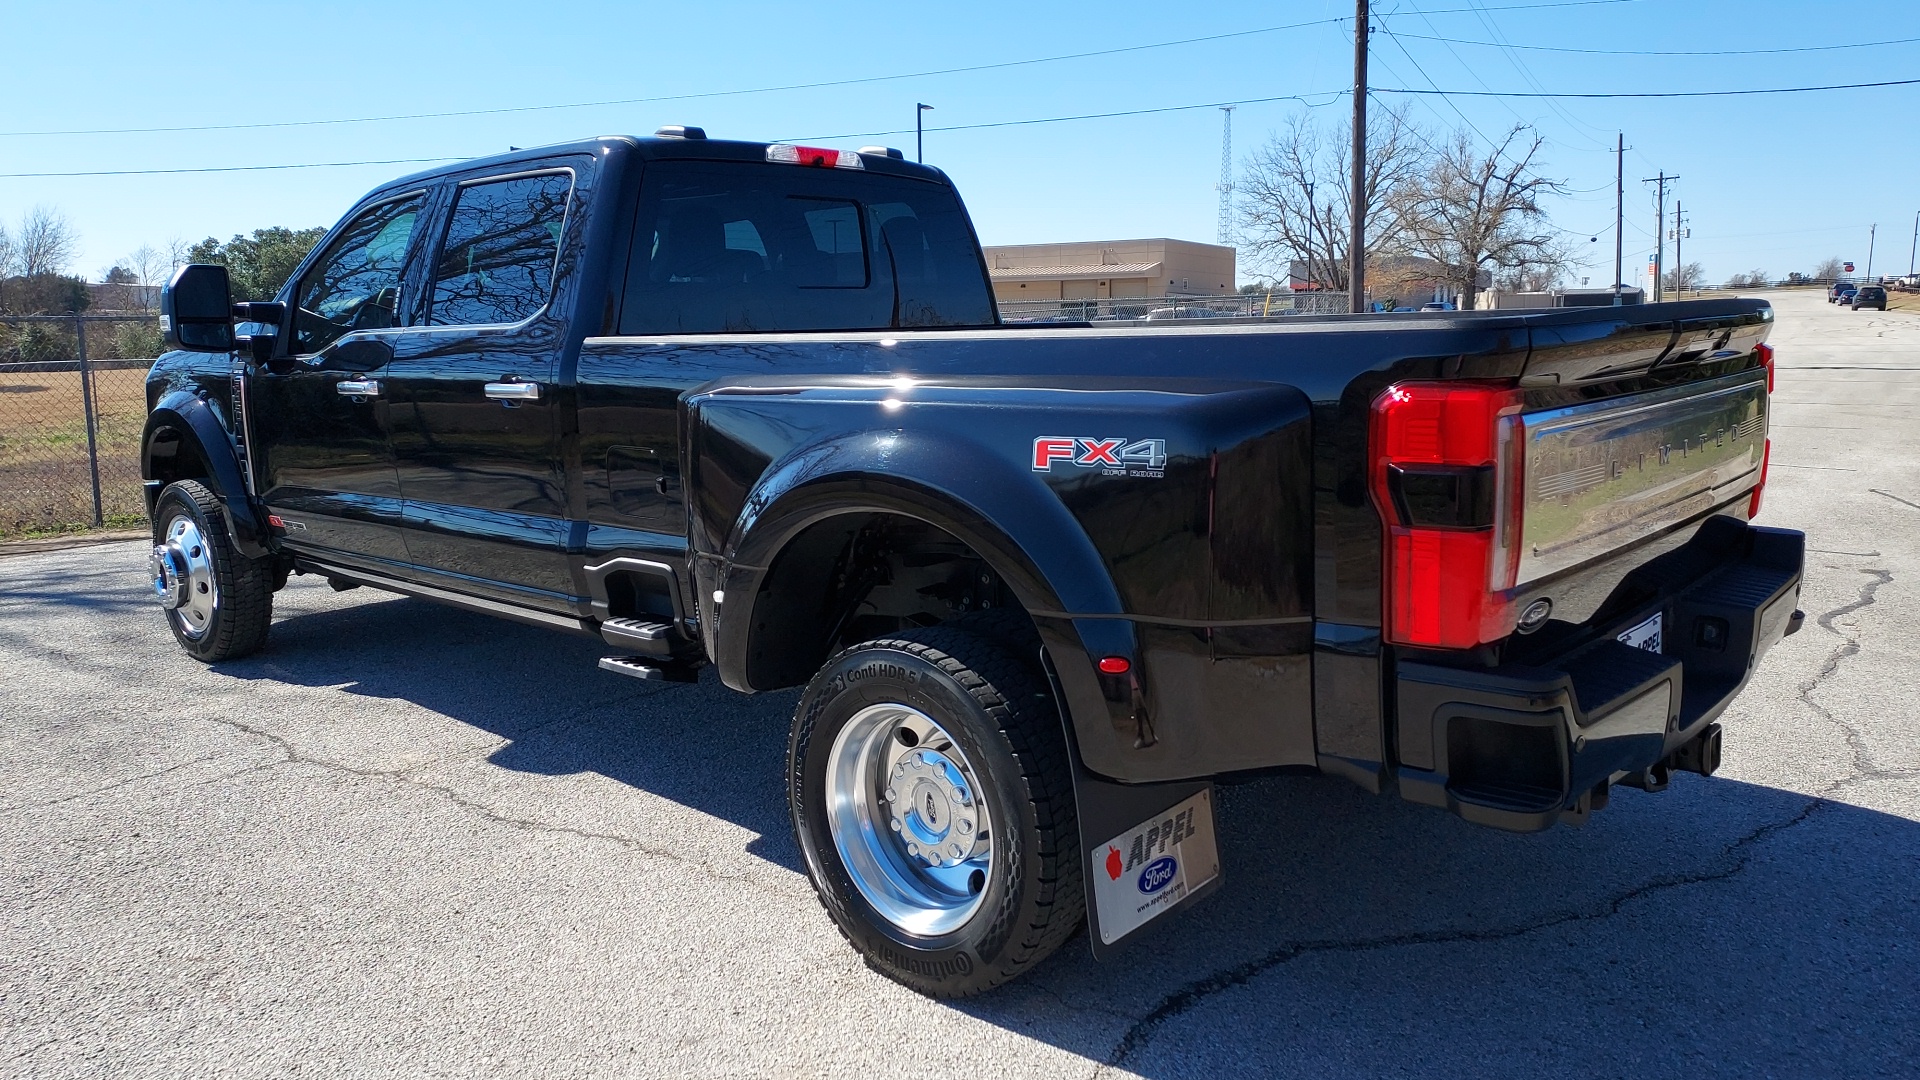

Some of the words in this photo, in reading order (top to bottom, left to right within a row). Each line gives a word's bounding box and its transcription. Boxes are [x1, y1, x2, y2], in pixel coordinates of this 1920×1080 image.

[1032, 436, 1167, 472] FX4
[1611, 424, 1739, 479] LIMITED
[1130, 470, 1164, 478] ROAD
[847, 664, 877, 683] Conti
[878, 663, 906, 681] HDR
[908, 670, 917, 684] 5
[1125, 806, 1196, 873] APPEL
[1144, 861, 1173, 891] Ford
[877, 943, 974, 982] Continental
